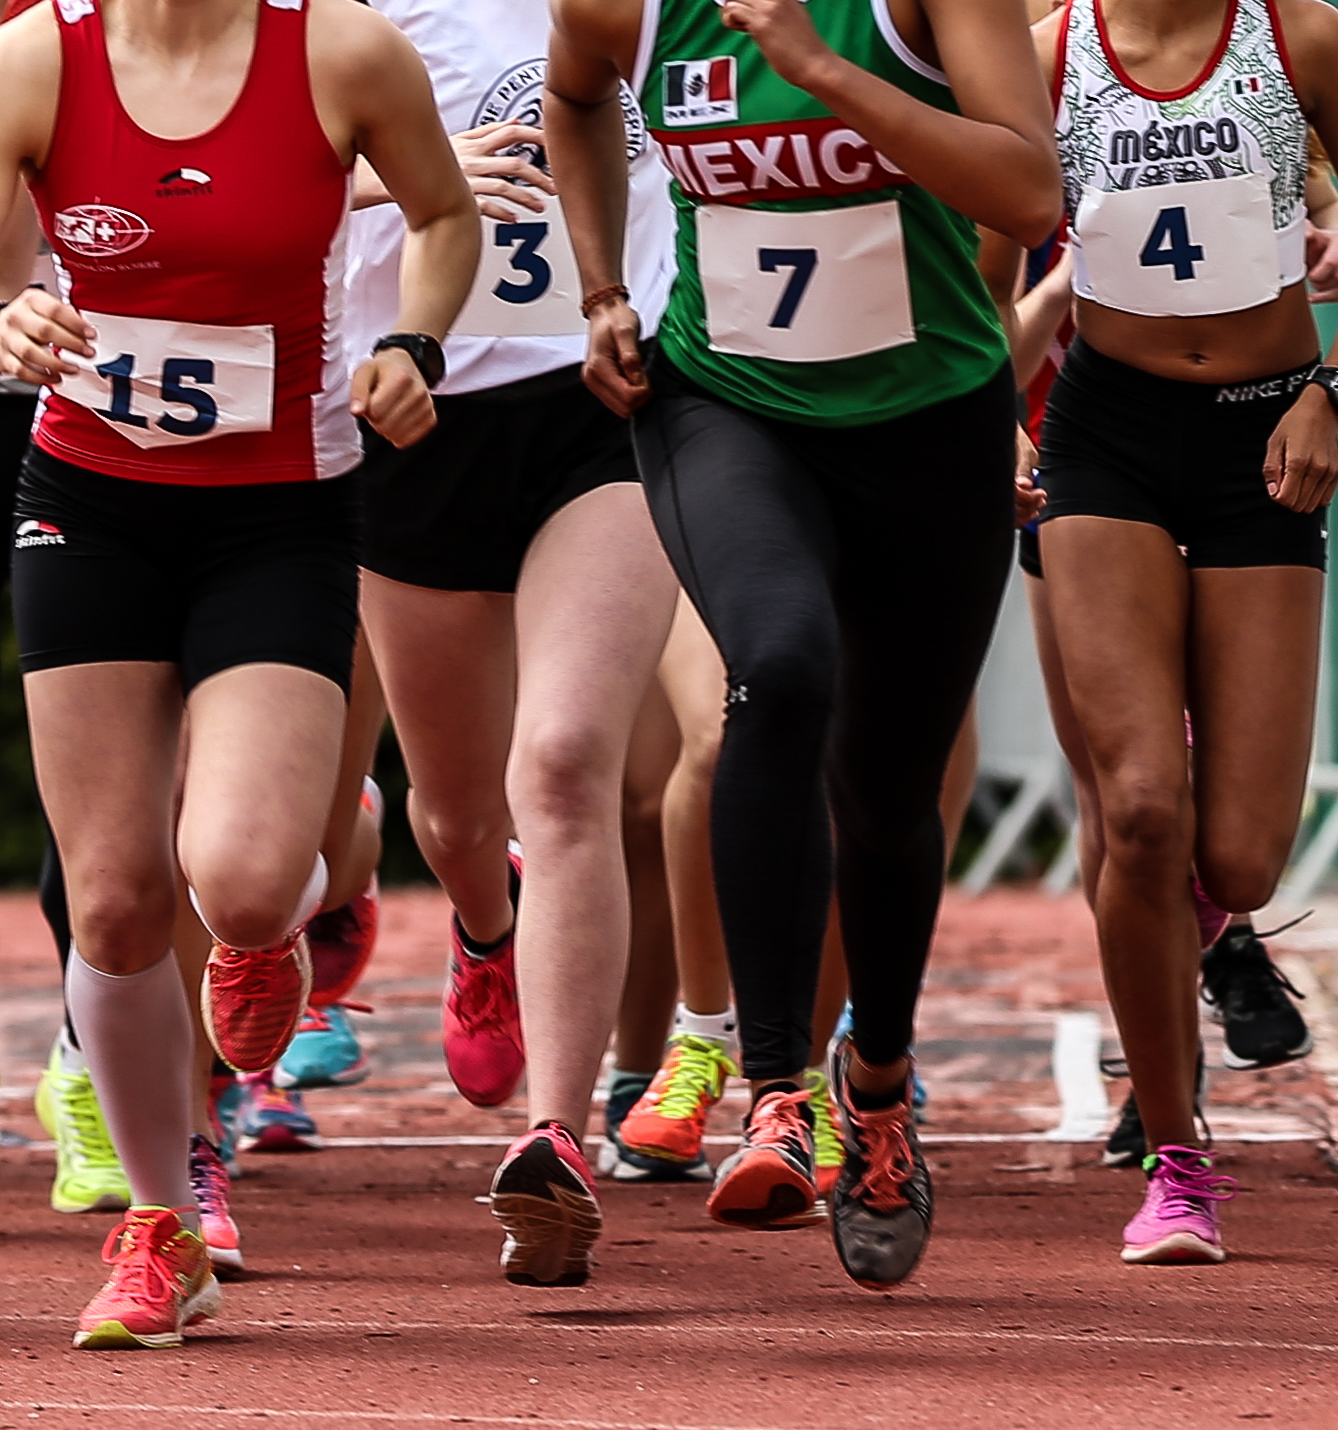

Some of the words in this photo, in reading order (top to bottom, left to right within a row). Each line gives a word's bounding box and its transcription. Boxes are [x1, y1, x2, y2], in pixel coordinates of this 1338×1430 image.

[661, 128, 906, 197] MEXIC
[492, 222, 552, 304] 3
[1139, 206, 1205, 281] 4
[758, 248, 818, 329] 7
[93, 352, 220, 437] 15
[1216, 379, 1283, 403] NIKE
